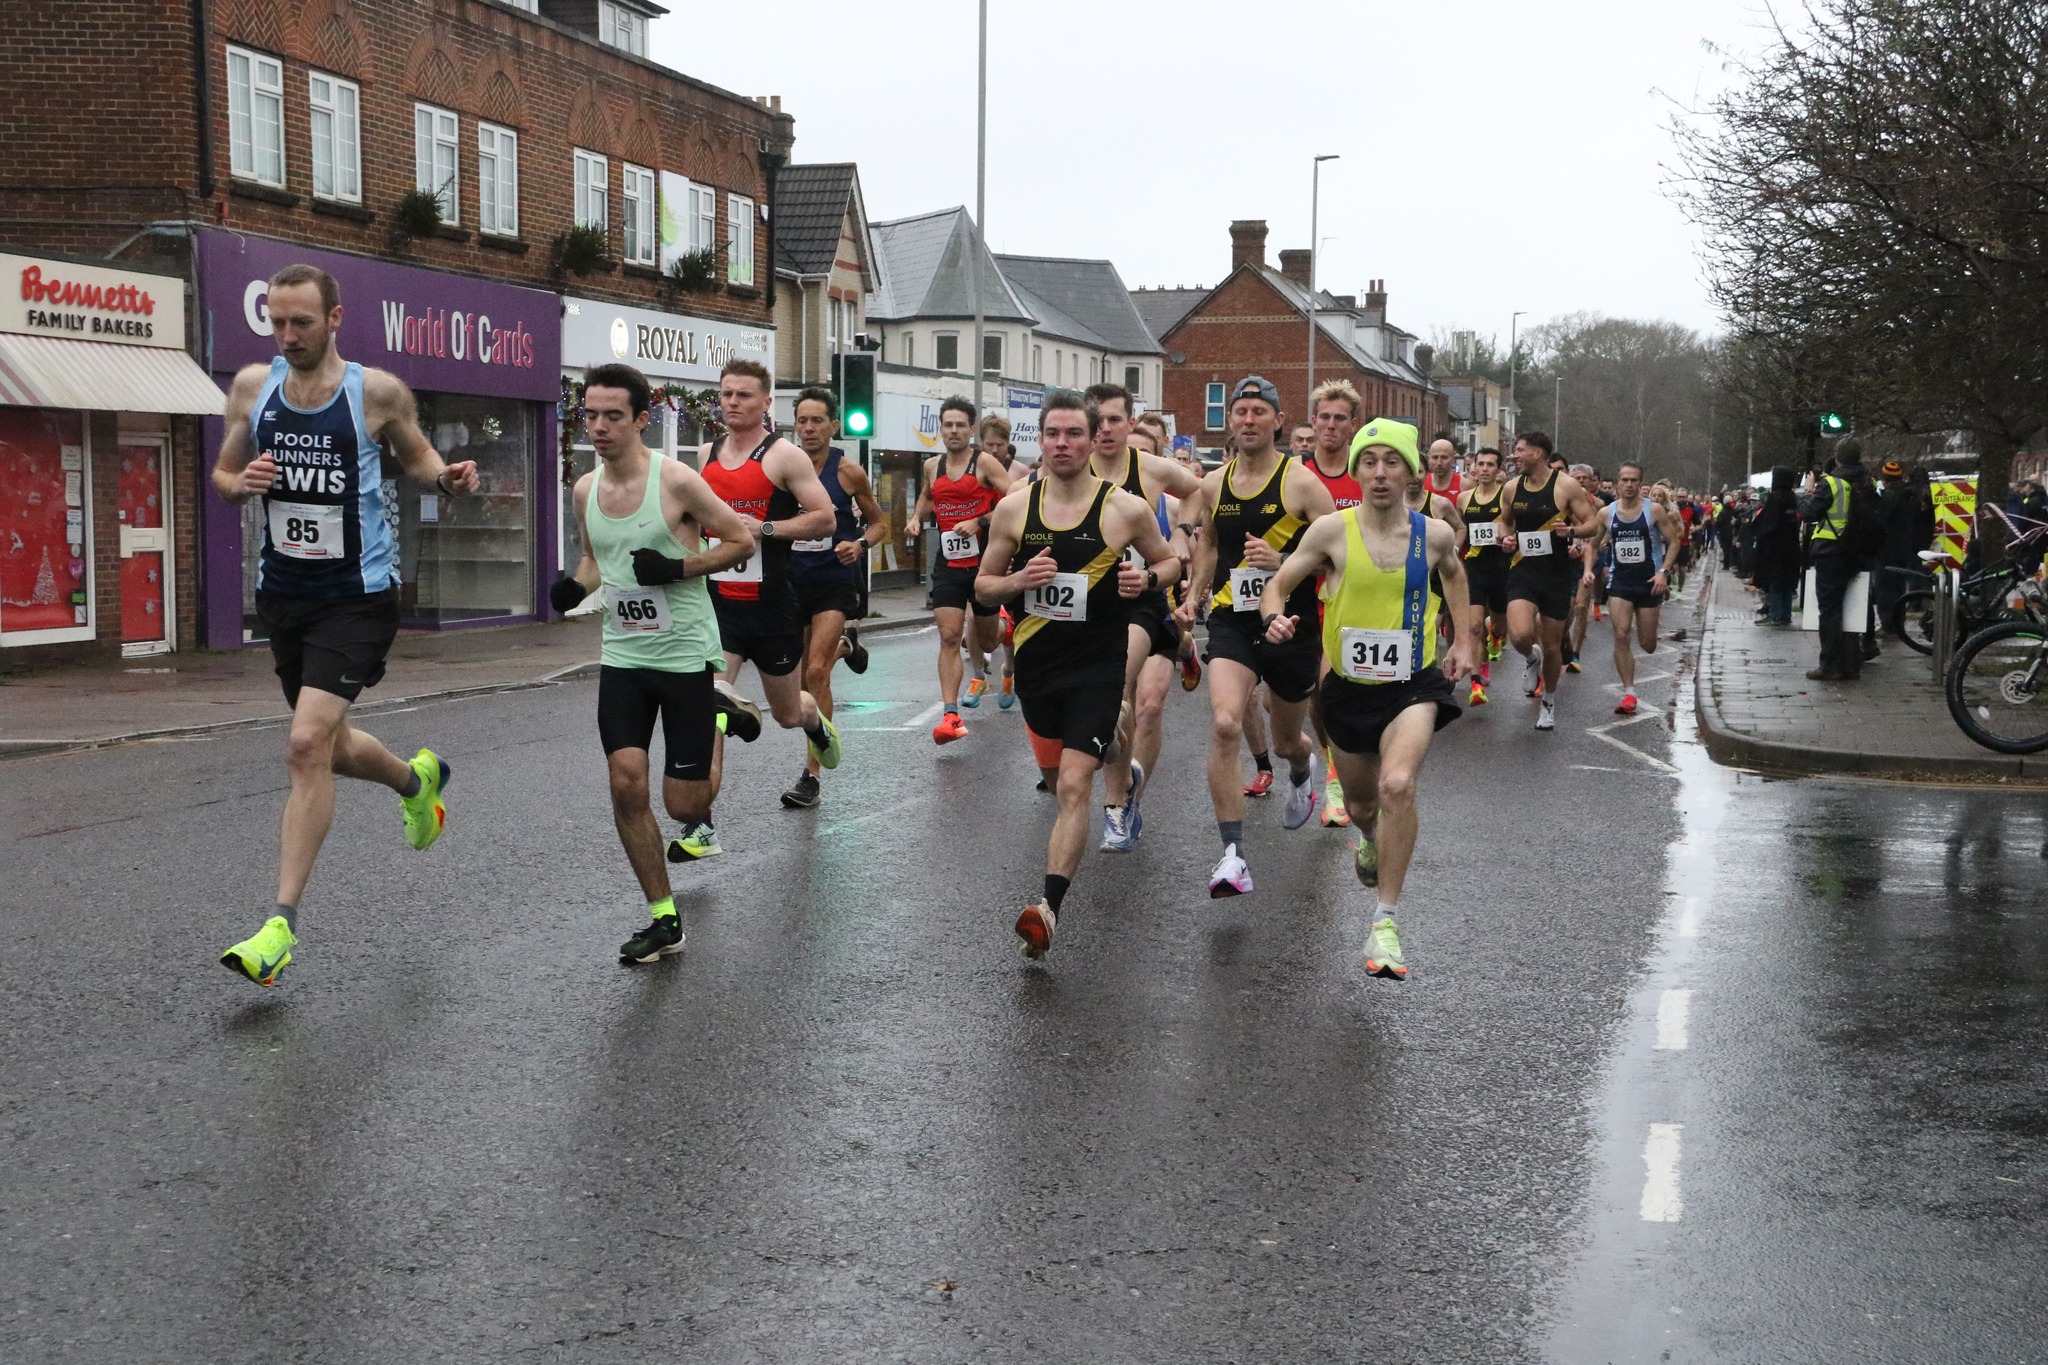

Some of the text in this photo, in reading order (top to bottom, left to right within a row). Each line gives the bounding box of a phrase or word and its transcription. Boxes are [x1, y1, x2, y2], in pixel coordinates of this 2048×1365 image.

[22, 265, 156, 316] Bennetts
[28, 309, 153, 338] FAMILY BAKERS
[382, 300, 534, 369] World Of Cards
[636, 323, 736, 369] ROYAL Nails
[274, 432, 332, 449] POOLE
[1010, 432, 1040, 442] Trave
[272, 466, 346, 495] EWIS
[731, 499, 766, 509] HEATH
[1933, 495, 1975, 504] MAINTENANC
[286, 517, 319, 544] 85
[1025, 533, 1054, 541] POOLE
[1474, 528, 1493, 539] 183
[946, 537, 971, 552] 375
[1413, 535, 1422, 559] soar
[1526, 538, 1542, 550] 89
[1620, 547, 1640, 558] 382
[1035, 586, 1075, 608] 102
[617, 598, 658, 621] 466
[1352, 641, 1399, 666] 314
